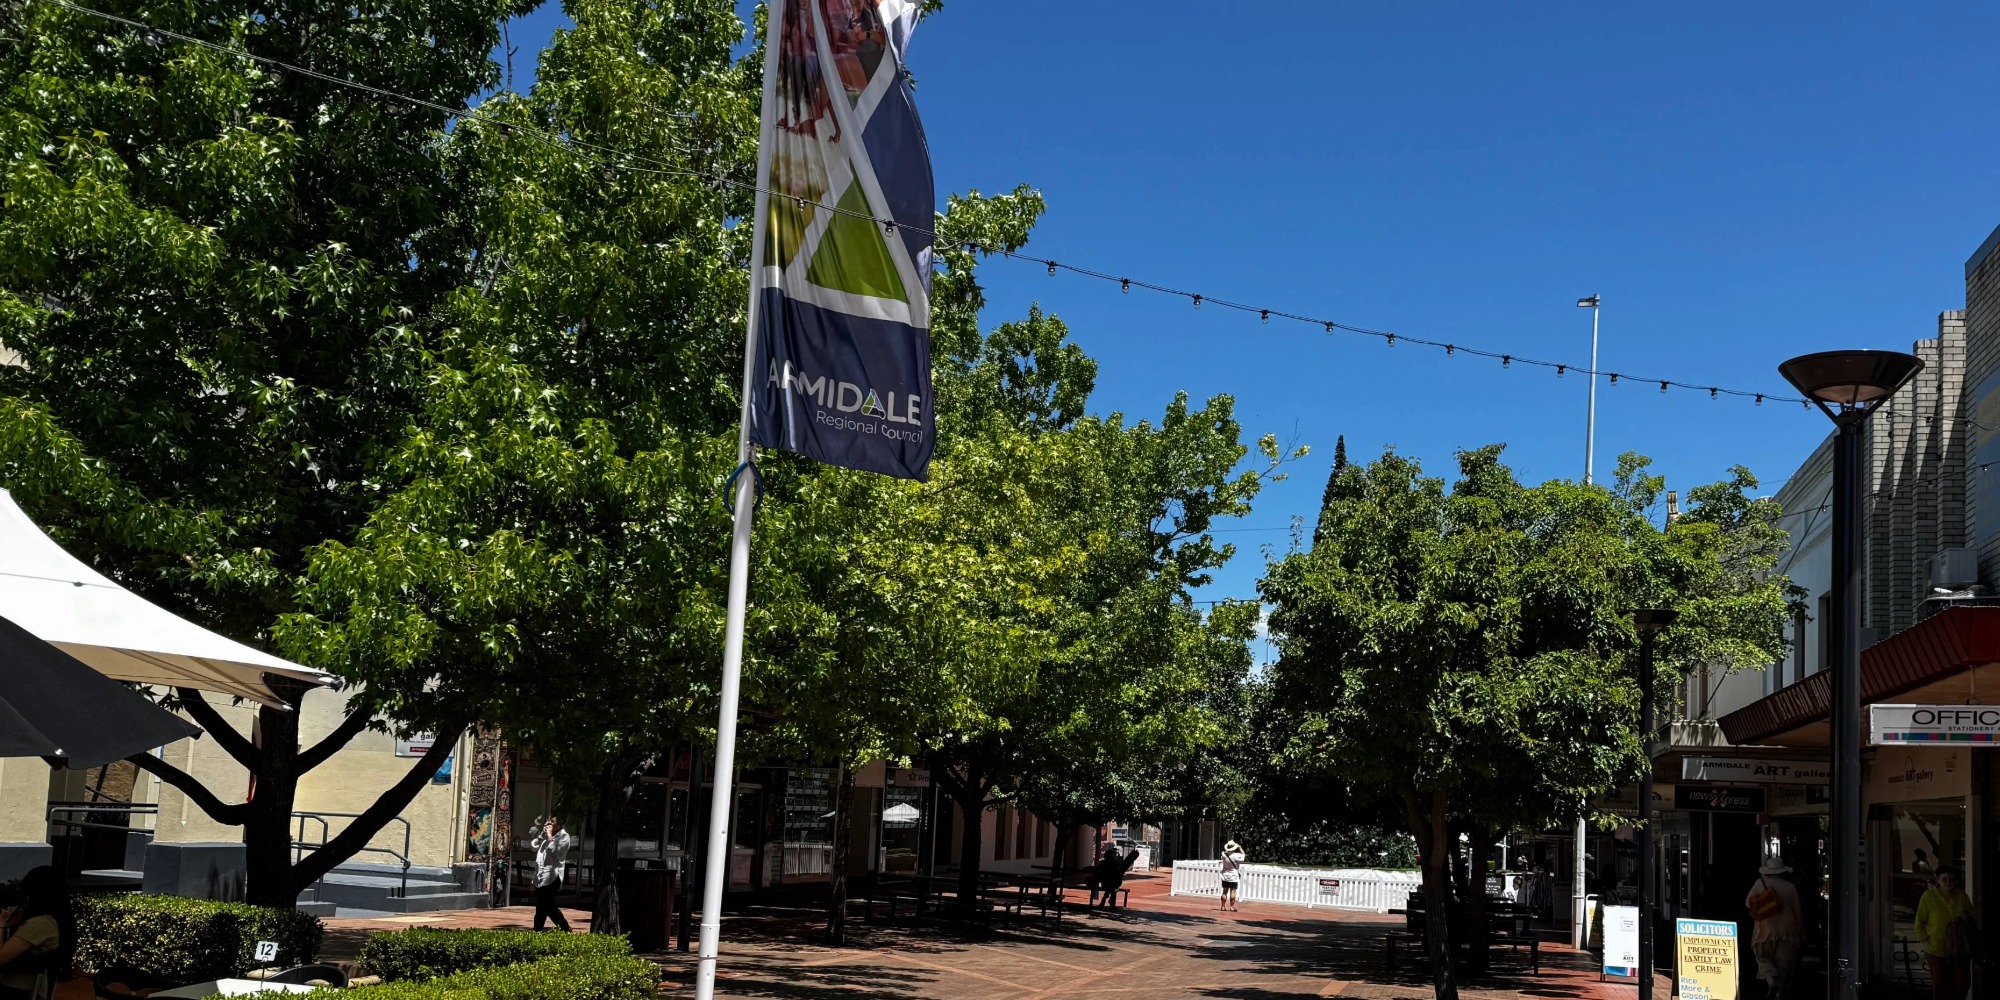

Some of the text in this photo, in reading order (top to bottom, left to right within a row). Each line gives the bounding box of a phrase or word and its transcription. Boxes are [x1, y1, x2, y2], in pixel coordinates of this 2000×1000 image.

[767, 357, 921, 426] ARMIDALE
[816, 410, 923, 444] Regional Council
[1912, 710, 2000, 726] OFFIC
[1754, 765, 1790, 776] ART
[1680, 923, 1733, 935] SOLICITORS
[1683, 937, 1731, 946] EMPLOYMENT
[261, 943, 273, 955] 12
[1687, 946, 1728, 955] PROPERTY
[1684, 955, 1713, 963] FAMILY
[1695, 965, 1722, 973] CRIME
